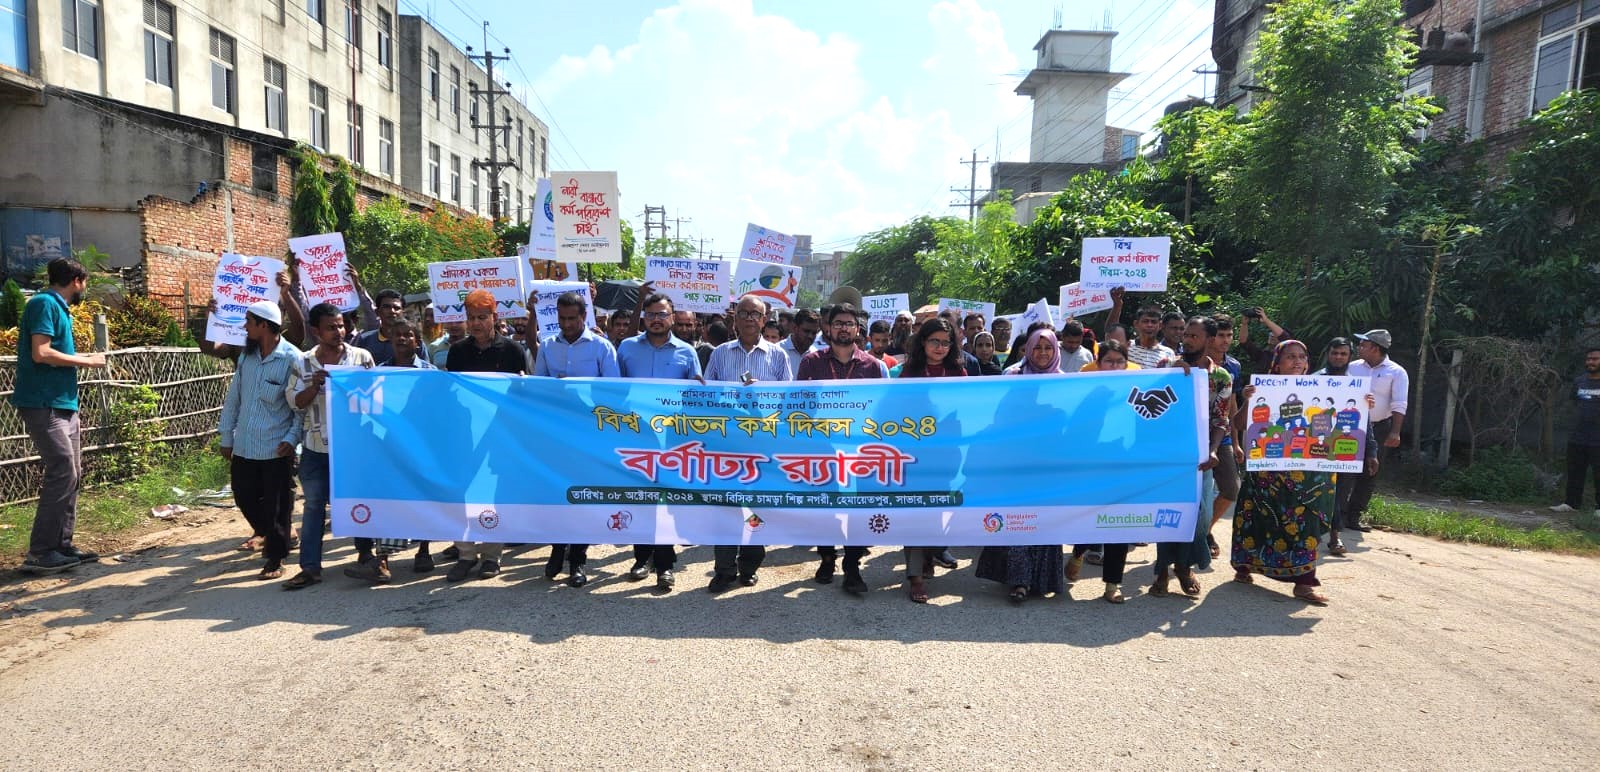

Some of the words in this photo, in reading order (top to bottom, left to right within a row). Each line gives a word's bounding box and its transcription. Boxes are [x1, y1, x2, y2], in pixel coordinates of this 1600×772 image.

[560, 178, 579, 198] নারী
[559, 200, 576, 215] কর্ম
[573, 221, 599, 237] চাই।
[1114, 239, 1132, 250] বিশ্ব
[870, 298, 897, 309] JUST
[1255, 377, 1288, 387] Decent
[1296, 378, 1319, 387] Work
[1327, 378, 1342, 387] for
[1349, 379, 1362, 388] All
[745, 391, 752, 400] ও
[706, 400, 748, 410] Deserve
[752, 401, 783, 410] Peace
[787, 401, 806, 410] and
[592, 406, 641, 433] বিশ্ব
[649, 412, 731, 438] শোভন
[734, 411, 782, 438] কর্ম
[786, 411, 855, 438] দিবস
[862, 415, 937, 441] ২০২৪
[614, 440, 770, 485] বর্ণাঢ্য
[1317, 461, 1358, 471] Foundation
[607, 492, 621, 500] ০৮
[667, 492, 694, 502] ২০২৪
[726, 491, 754, 504] বিসিক
[756, 495, 783, 506] চামড়া
[785, 492, 805, 505] শিল্প
[1096, 512, 1153, 524] Mondiaal
[1155, 511, 1183, 525] FNV
